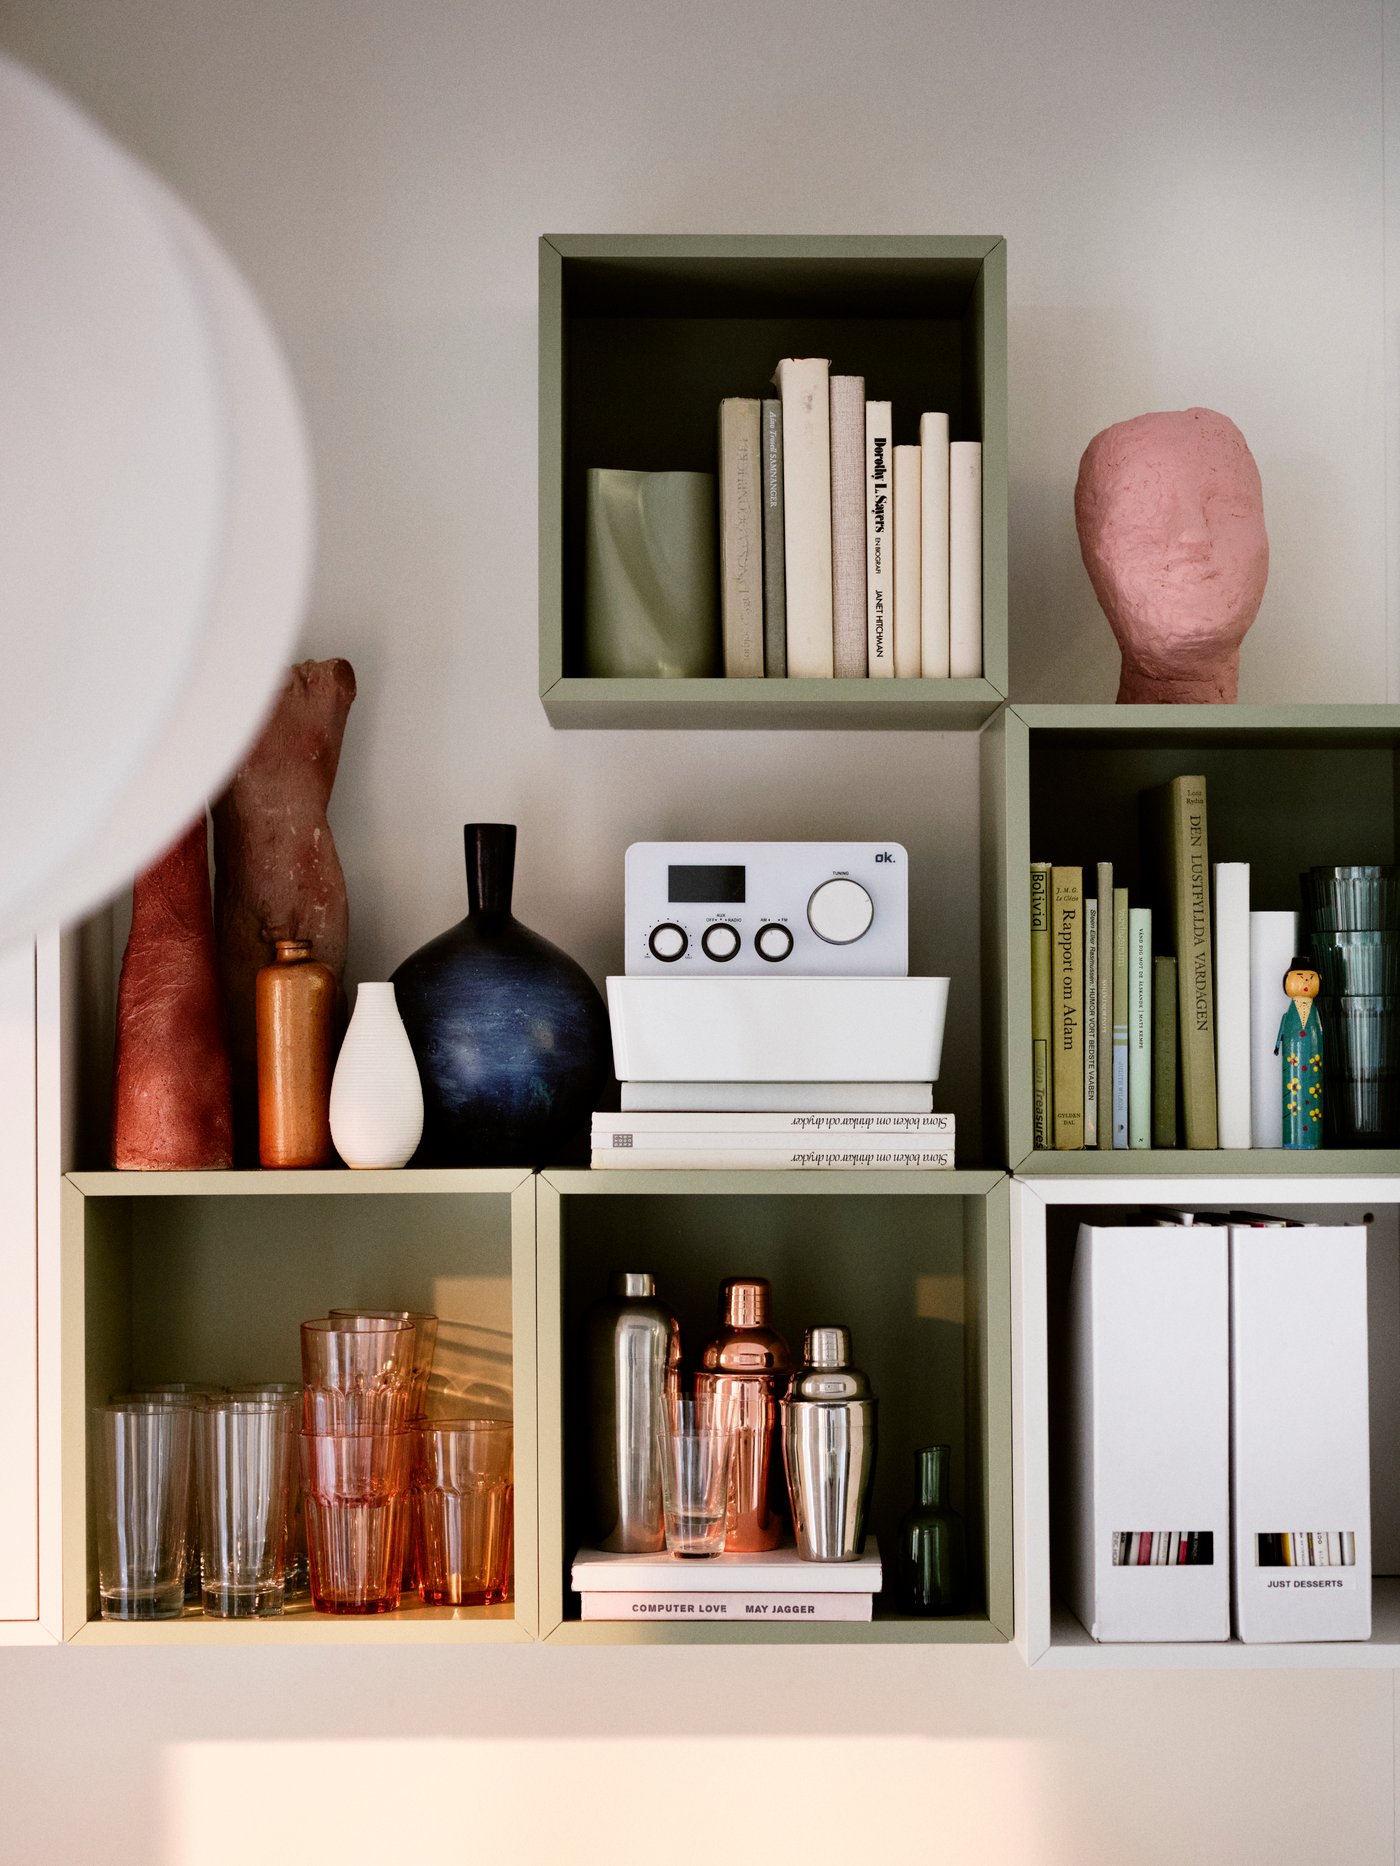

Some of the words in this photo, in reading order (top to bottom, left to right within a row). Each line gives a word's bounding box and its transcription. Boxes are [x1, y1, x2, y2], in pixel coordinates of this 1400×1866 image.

[769, 411, 777, 429] Aino
[871, 437, 887, 480] Dorothy
[769, 454, 778, 508] SAMNANGER
[871, 495, 888, 533] Sayers
[874, 537, 881, 546] EN
[874, 547, 882, 574] BIOGRAFI
[875, 590, 884, 614] JANET
[876, 616, 884, 658] HITCHMAN
[1190, 815, 1201, 847] DEN
[1032, 874, 1045, 927] Bolivia
[1191, 855, 1205, 946] LUSTFYLLDA
[1089, 909, 1097, 929] Steen
[1058, 909, 1076, 973] Rapport
[1063, 976, 1073, 1000] om
[1194, 952, 1208, 1032] VARDAGEN
[1088, 987, 1096, 1016] HUMOR
[1063, 1004, 1078, 1051] Adam
[1088, 1018, 1096, 1038] VORT
[1088, 1039, 1096, 1069] BEDSTE
[791, 1115, 825, 1130] drycker
[825, 1117, 841, 1130] och
[841, 1117, 874, 1130] drinkar
[876, 1117, 892, 1126] om
[893, 1117, 920, 1130] boken
[922, 1117, 949, 1130] Stora
[1034, 1087, 1045, 1149] Treasures
[791, 1151, 825, 1166] drycker
[825, 1153, 841, 1166] och
[841, 1153, 874, 1166] drinkar
[876, 1153, 892, 1162] om
[893, 1153, 920, 1166] boken
[922, 1153, 949, 1166] Stora
[1267, 1580, 1291, 1588] JUST
[1293, 1580, 1344, 1588] DESSERTS
[631, 1604, 695, 1613] COMPUTER
[699, 1604, 727, 1613] LOVE
[745, 1605, 768, 1614] MAY
[772, 1605, 815, 1614] JAGGER
